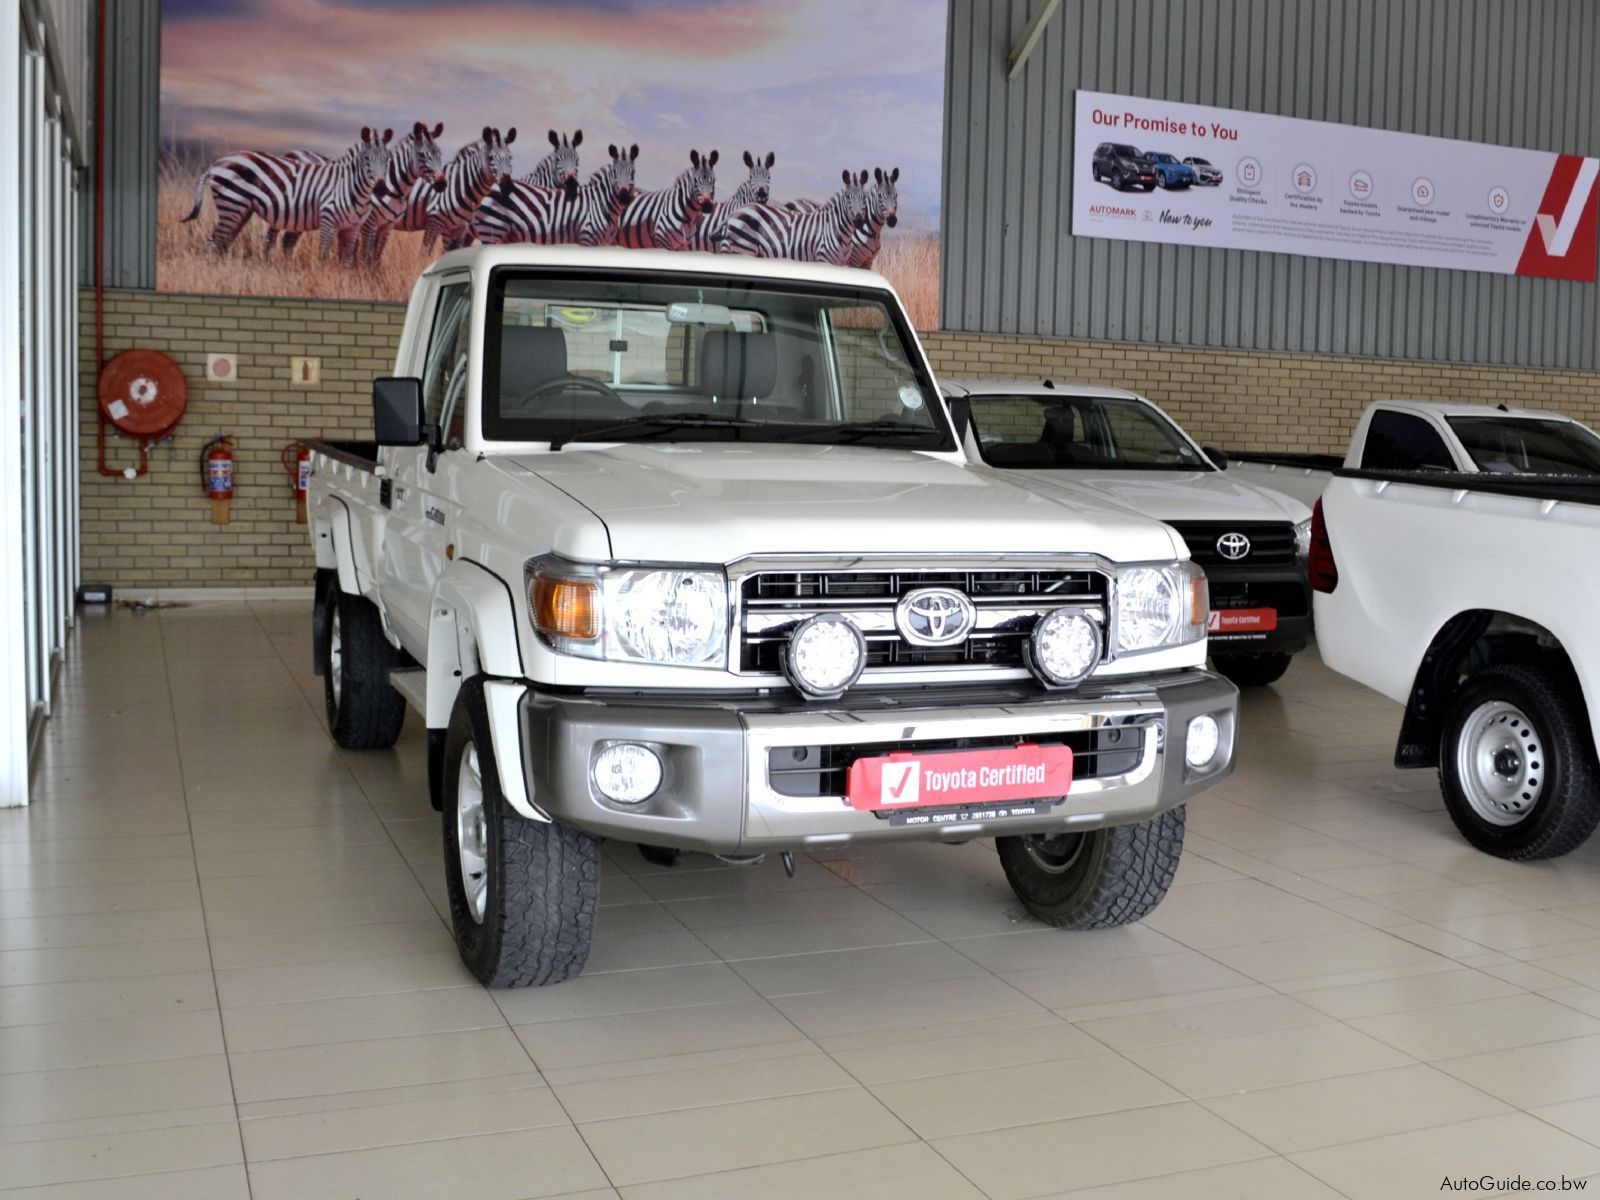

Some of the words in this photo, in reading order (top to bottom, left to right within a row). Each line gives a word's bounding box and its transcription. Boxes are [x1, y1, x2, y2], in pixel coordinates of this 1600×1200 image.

[1092, 109, 1120, 127] Our
[1124, 112, 1187, 134] Promise
[1191, 121, 1207, 137] to
[1211, 123, 1238, 141] You
[1229, 195, 1248, 204] Quality
[1344, 200, 1360, 208] Toyota
[1089, 205, 1137, 217] AUTOMARK
[1159, 209, 1181, 225] New
[1182, 213, 1193, 225] to
[1193, 218, 1213, 230] you
[1490, 223, 1505, 231] Toyota
[1221, 617, 1238, 625] Toyota
[1239, 615, 1260, 624] Certified
[924, 770, 977, 792] Toyota
[979, 763, 1046, 787] Certified
[906, 816, 930, 825] MOTOR
[932, 813, 957, 823] CENTRE
[1011, 807, 1036, 816] TOYOTA
